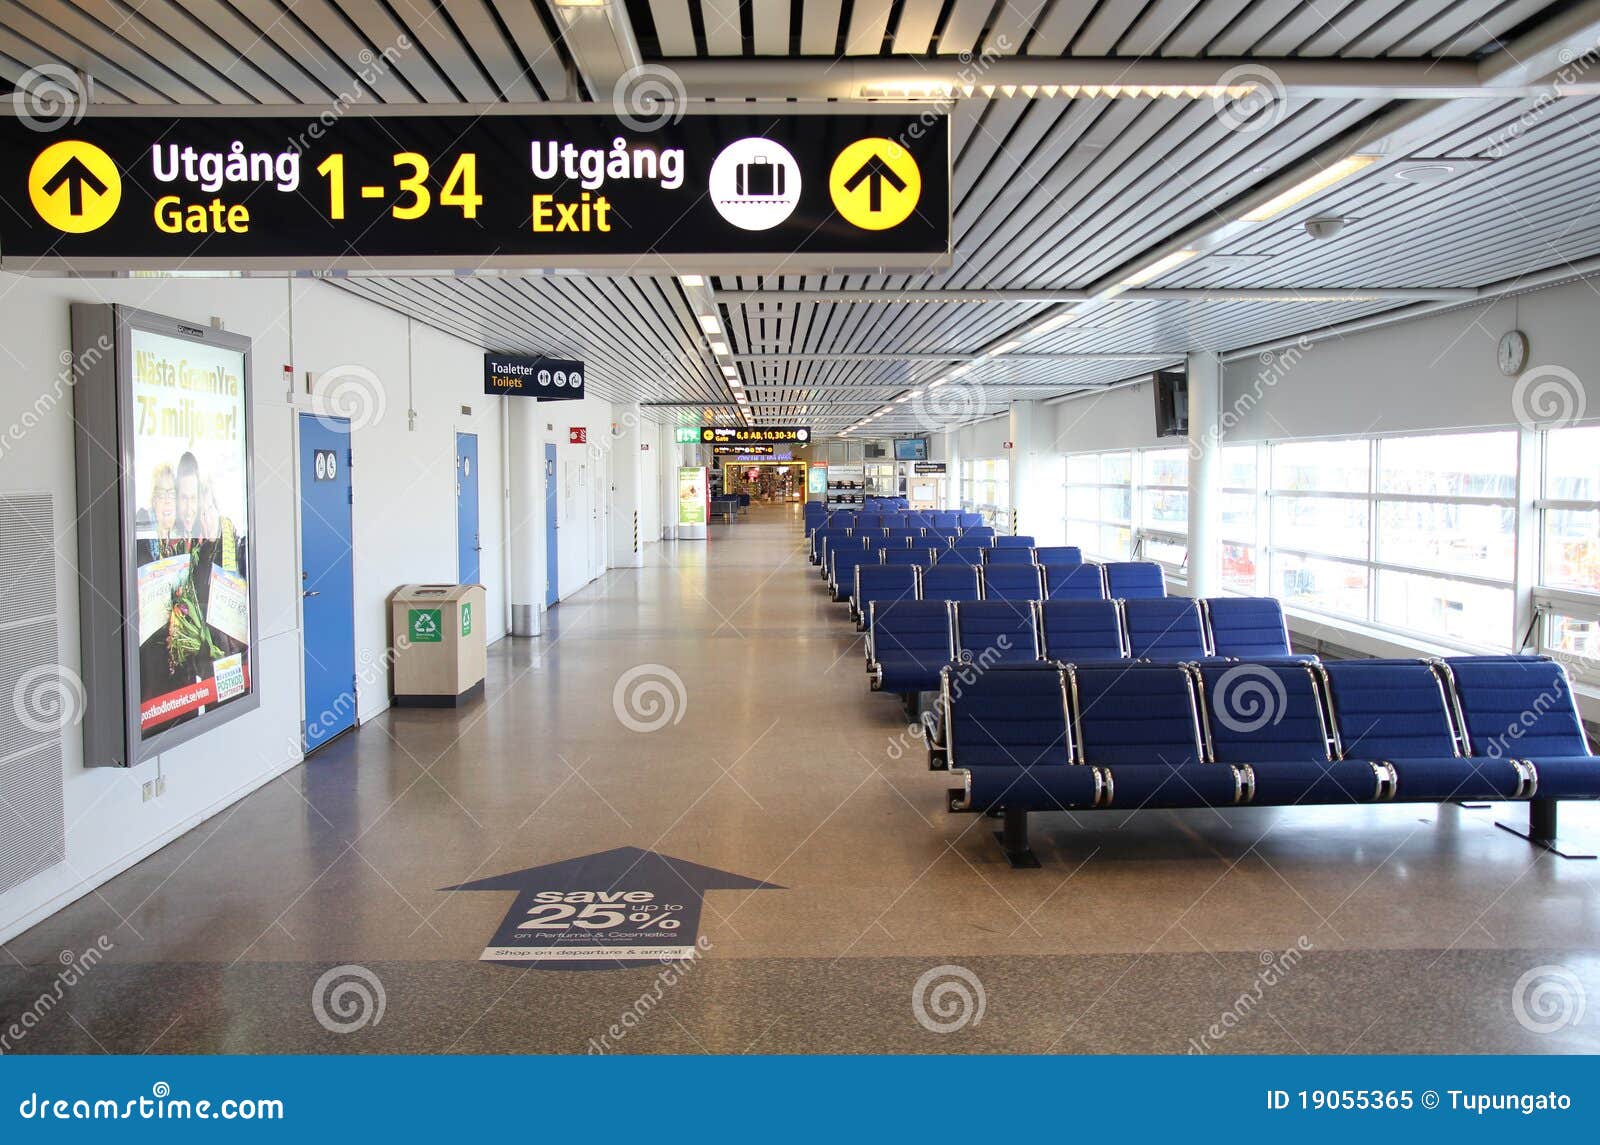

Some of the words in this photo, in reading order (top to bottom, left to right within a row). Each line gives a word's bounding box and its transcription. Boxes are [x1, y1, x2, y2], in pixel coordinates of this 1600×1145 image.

[152, 140, 299, 192] Utgång
[531, 137, 685, 189] Utgång
[316, 153, 483, 220] 1-34
[154, 196, 249, 234] Gate
[532, 193, 611, 232] Exit
[136, 350, 176, 387] Nästa
[491, 362, 534, 376] Toaletter
[491, 375, 523, 388] Toilets
[136, 395, 157, 436] 75
[533, 891, 655, 903] save
[631, 904, 658, 912] up
[664, 903, 684, 911] to
[516, 904, 681, 930] 25%
